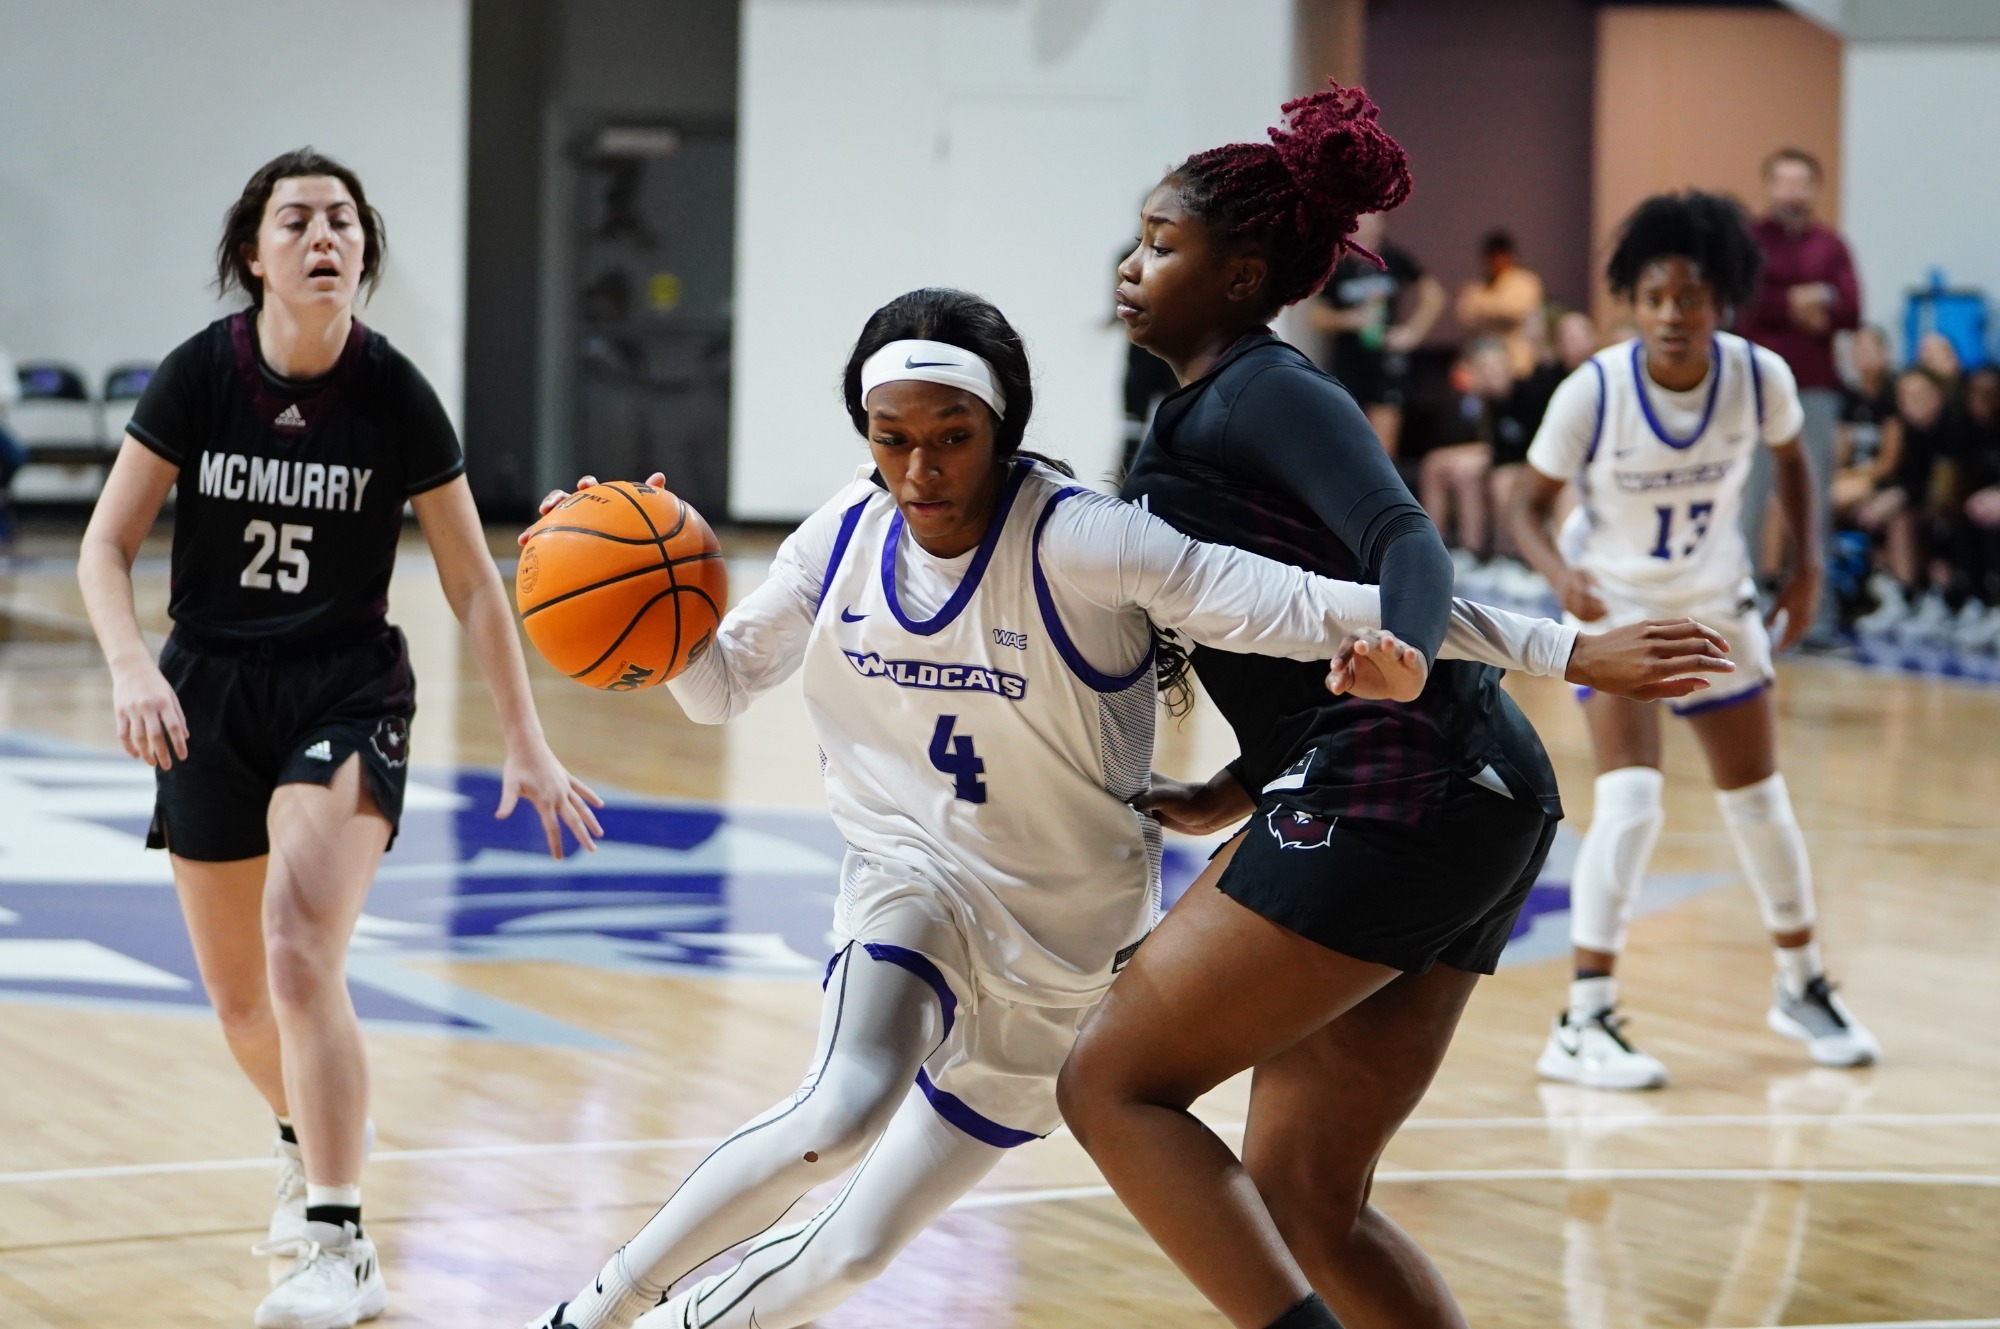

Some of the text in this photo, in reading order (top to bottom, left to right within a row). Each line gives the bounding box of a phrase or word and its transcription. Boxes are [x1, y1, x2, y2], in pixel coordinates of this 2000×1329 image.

[199, 450, 372, 512] MCMURRY
[240, 519, 313, 594] 25
[993, 629, 1027, 650] WAC
[844, 651, 1026, 699] WILDCATS
[929, 714, 987, 804] 4
